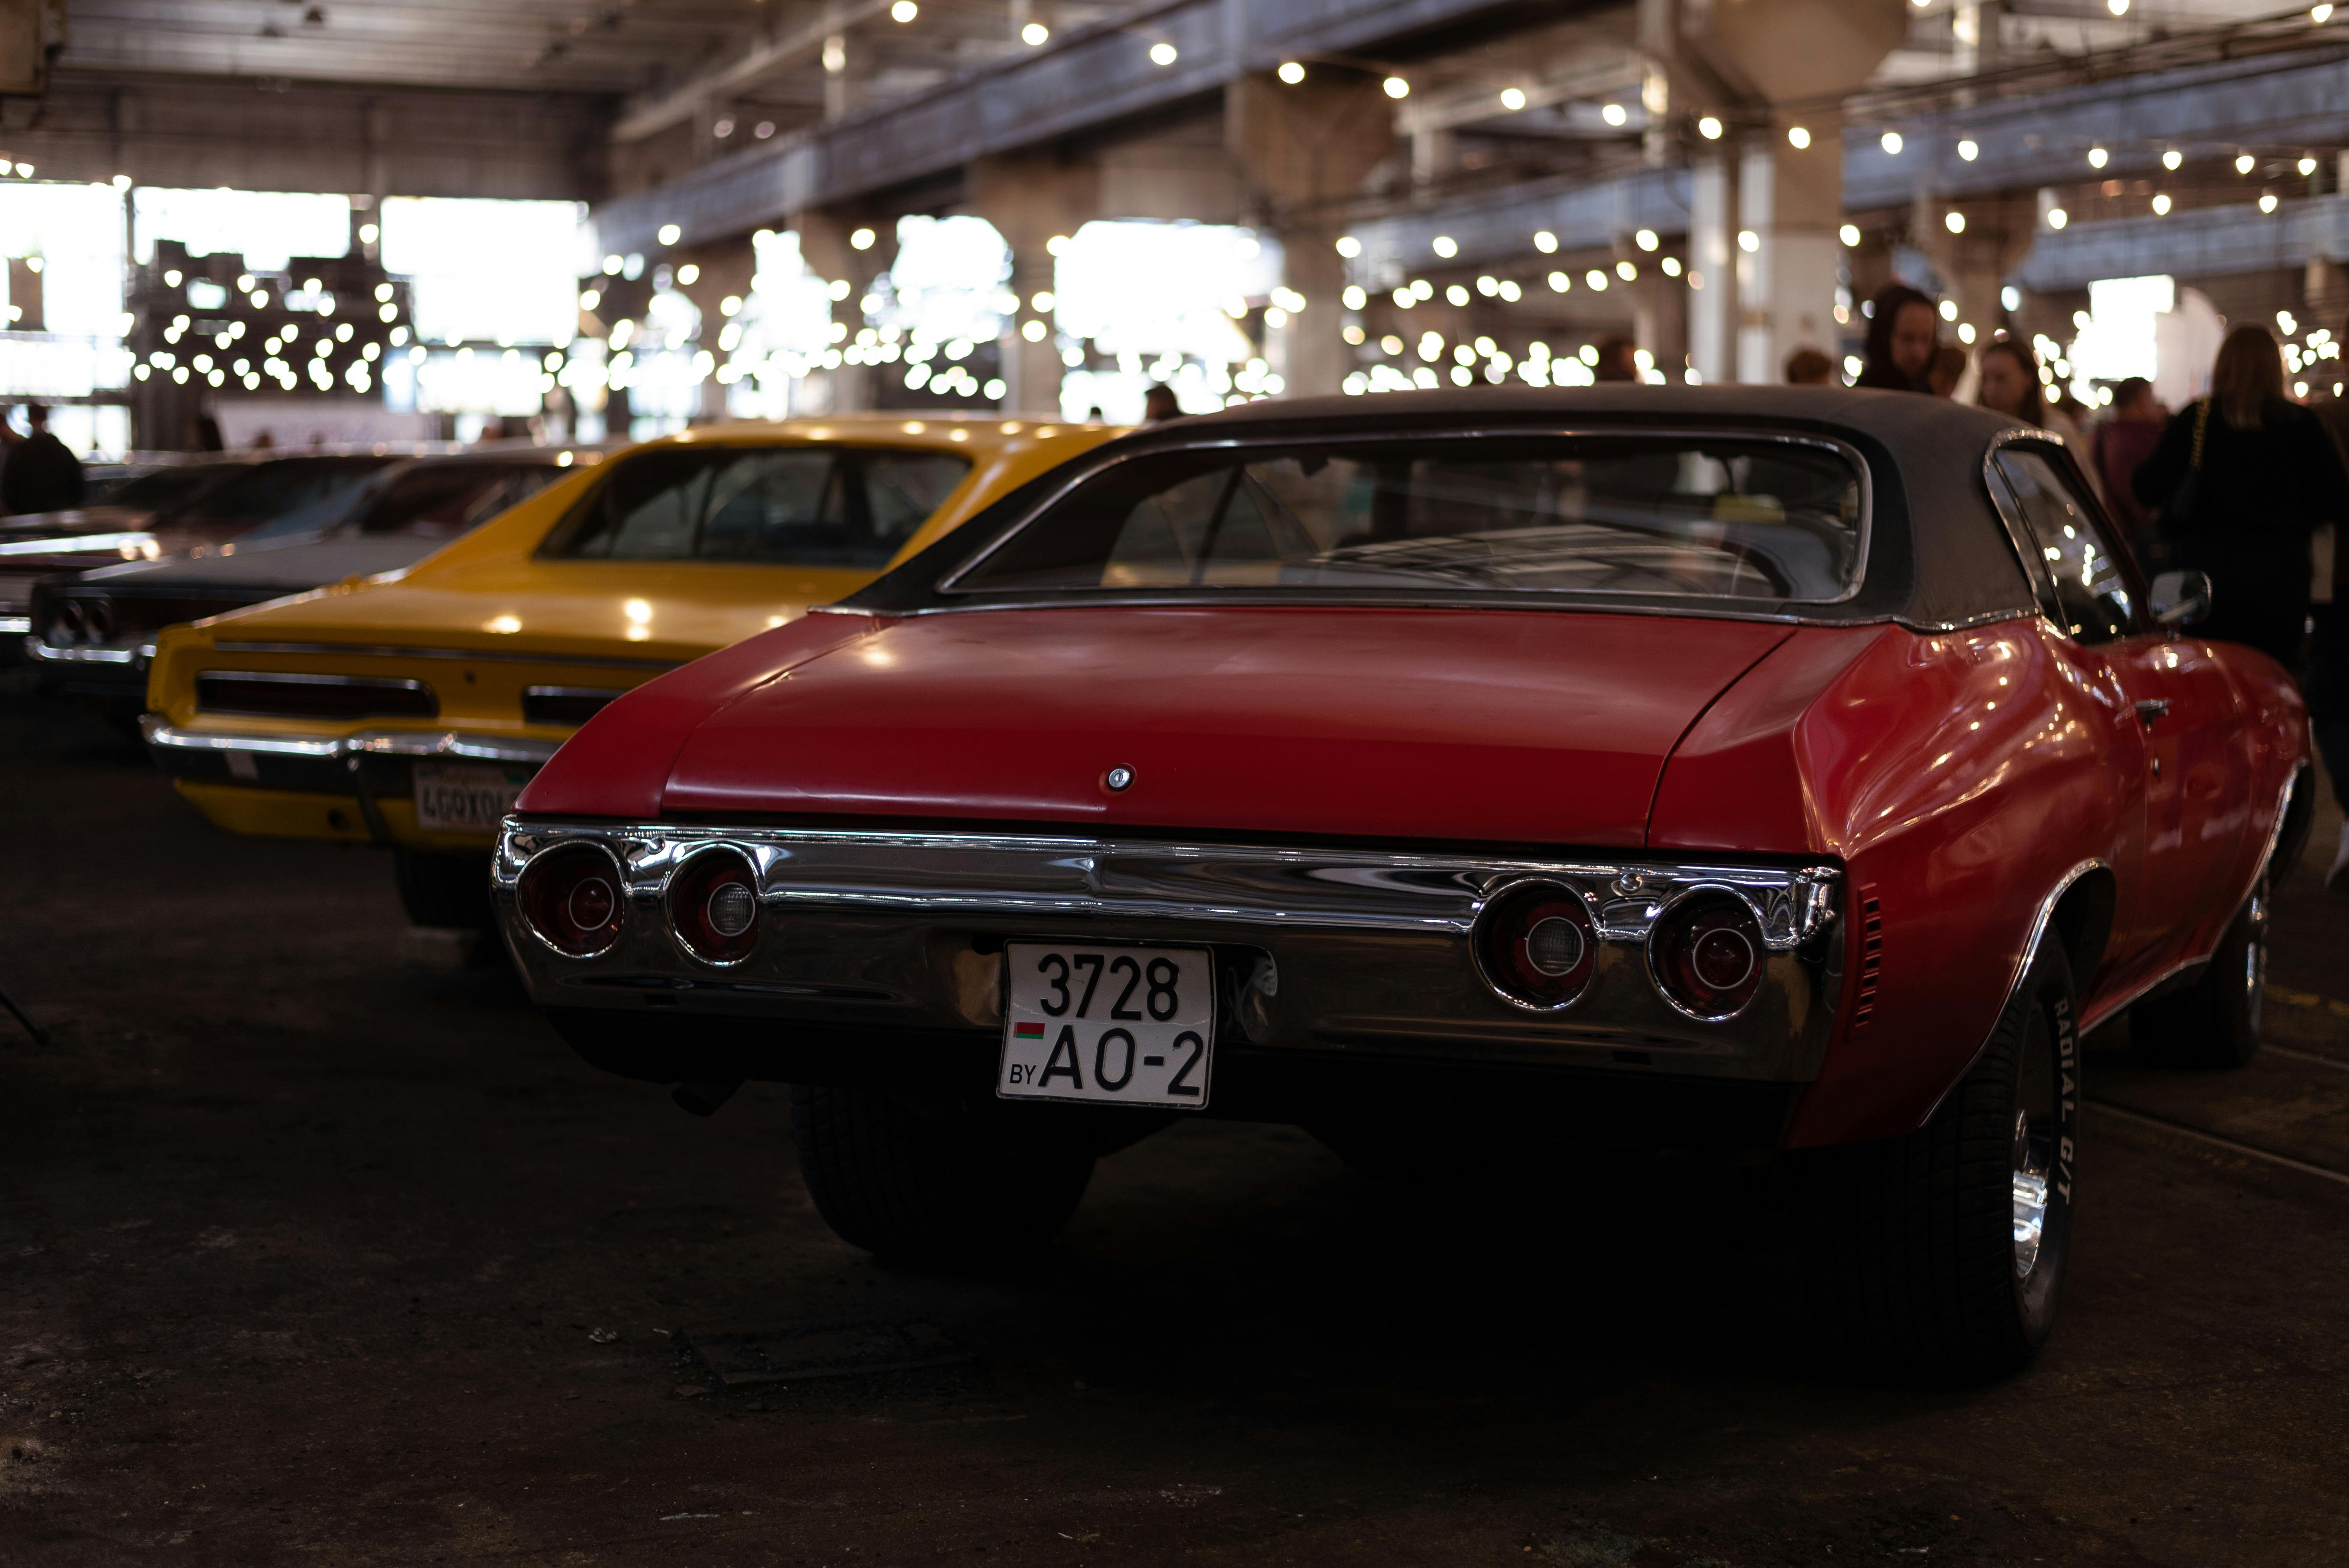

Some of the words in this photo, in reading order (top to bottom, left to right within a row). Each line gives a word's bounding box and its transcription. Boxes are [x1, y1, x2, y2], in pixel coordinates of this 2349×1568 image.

[1038, 953, 1179, 1021] 3728
[1010, 1064, 1036, 1084] BY
[1038, 1024, 1203, 1096] AO-2
[2054, 998, 2075, 1124] RADIAL
[2057, 1136, 2074, 1205] G/T
